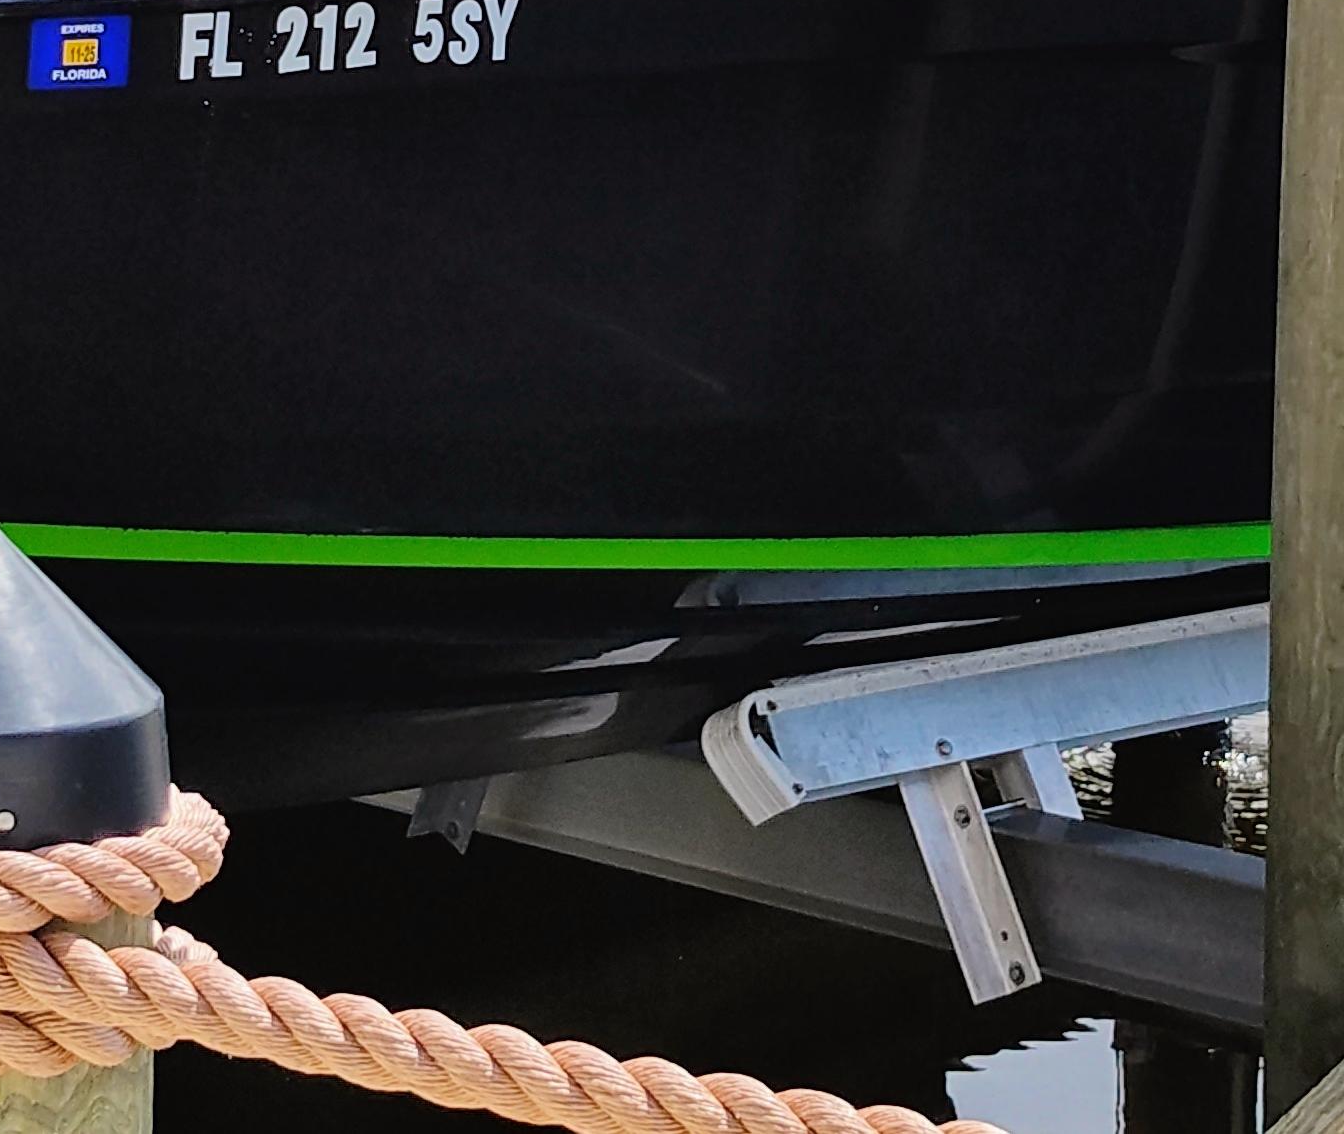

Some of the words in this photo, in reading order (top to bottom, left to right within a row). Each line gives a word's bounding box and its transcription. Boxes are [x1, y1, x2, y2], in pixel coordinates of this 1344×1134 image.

[60, 23, 105, 35] EXPIRES
[179, 10, 243, 81] FL
[276, 1, 377, 74] 212
[51, 68, 107, 81] FLORIDA
